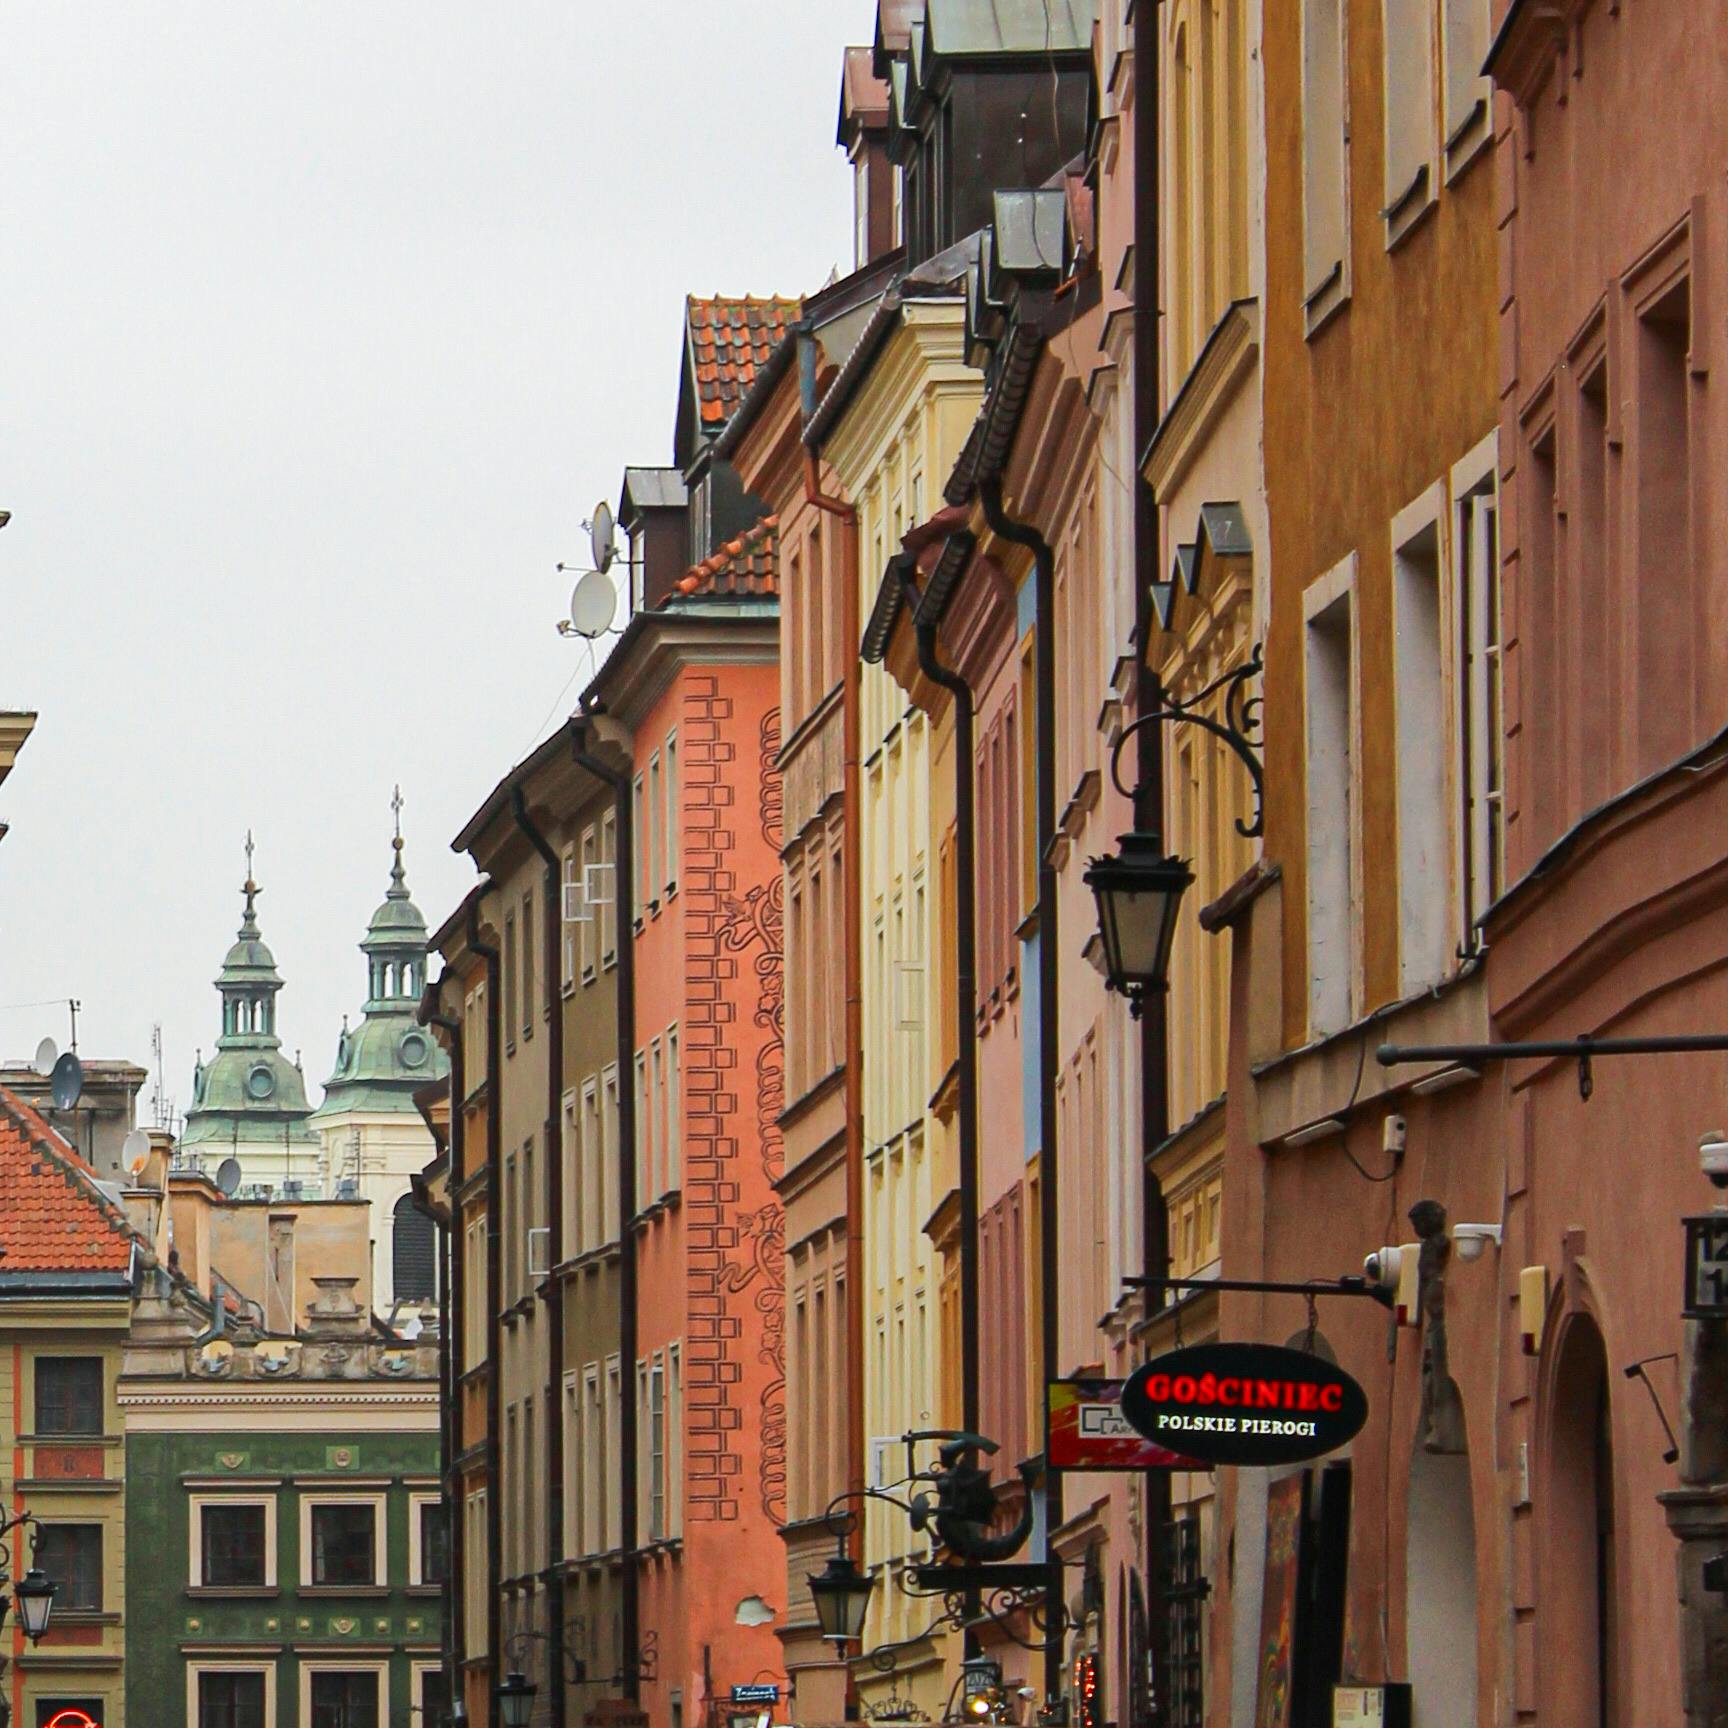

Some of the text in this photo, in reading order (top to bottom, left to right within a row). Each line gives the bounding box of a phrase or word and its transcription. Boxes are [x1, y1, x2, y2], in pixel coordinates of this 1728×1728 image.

[1145, 1372, 1343, 1411] GOŚCINIEC
[1158, 1415, 1236, 1432] POLSKIE
[1240, 1419, 1316, 1436] PIEROGI
